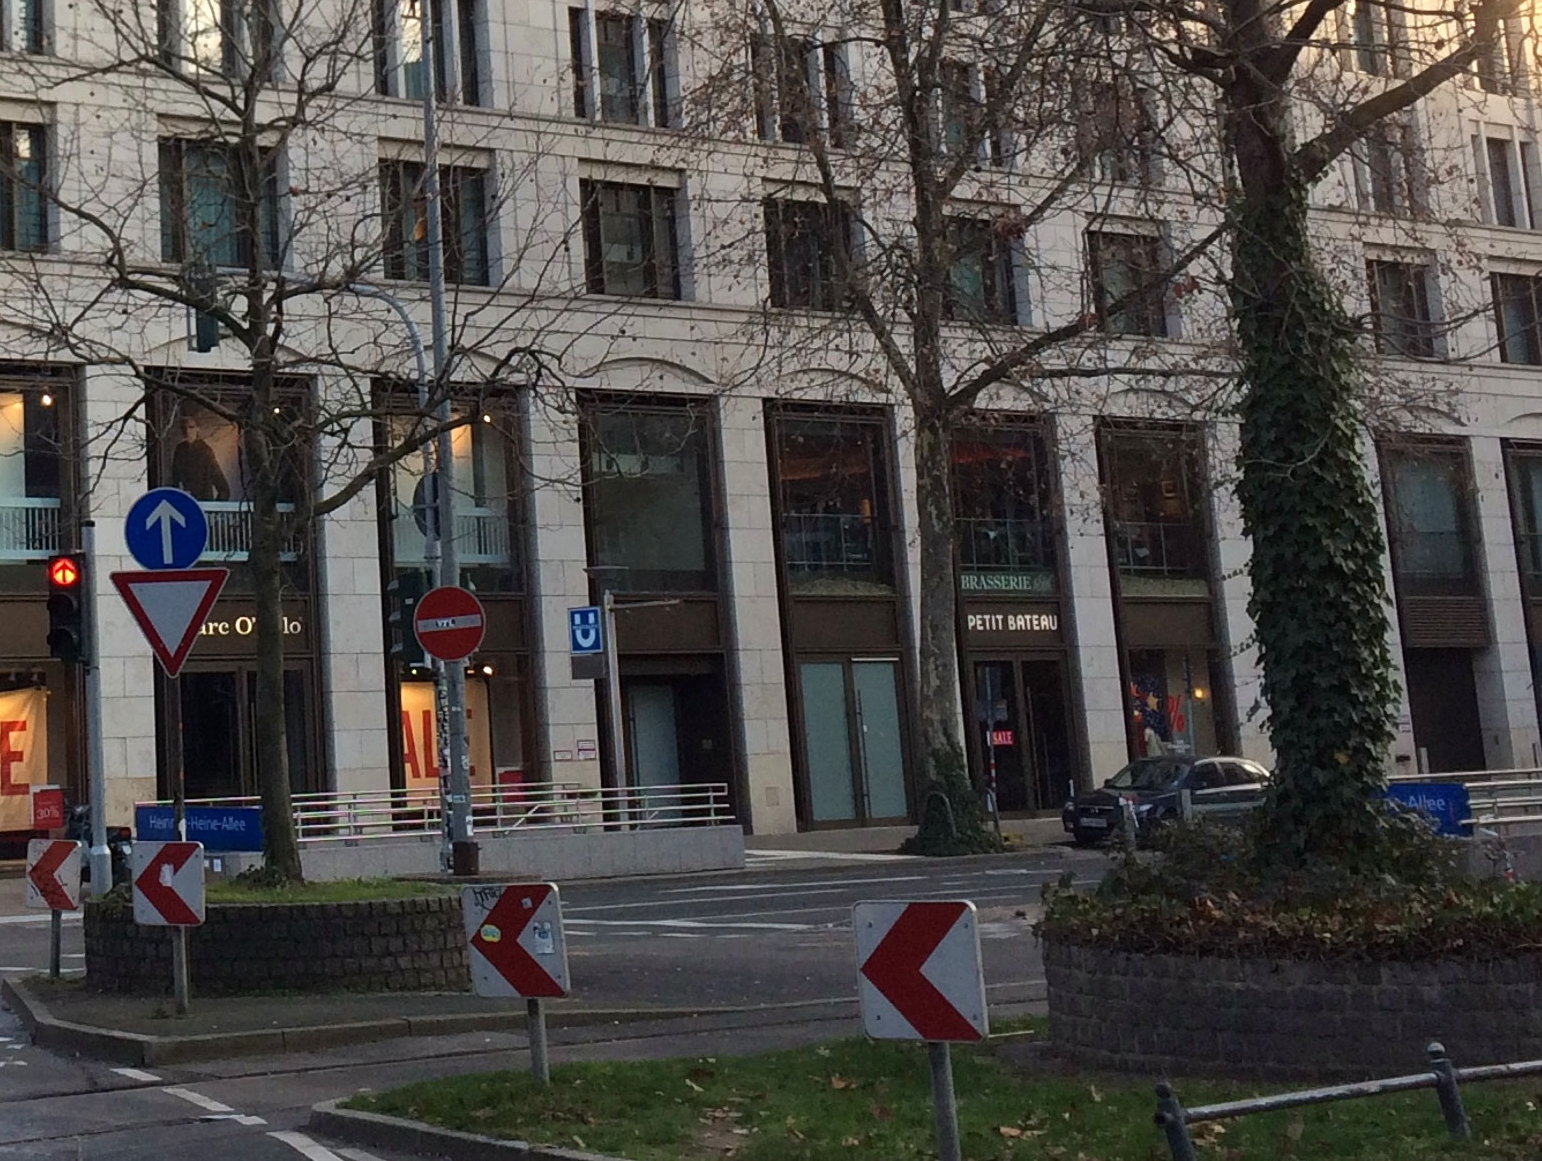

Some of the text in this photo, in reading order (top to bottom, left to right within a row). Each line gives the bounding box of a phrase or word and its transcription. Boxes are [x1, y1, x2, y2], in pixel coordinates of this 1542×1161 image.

[961, 575, 1031, 590] BRASSERIE
[198, 616, 302, 636] arc O'lo
[967, 614, 1058, 631] PETIT BATEAU
[992, 731, 1014, 745] SALE
[36, 806, 60, 820] 30%
